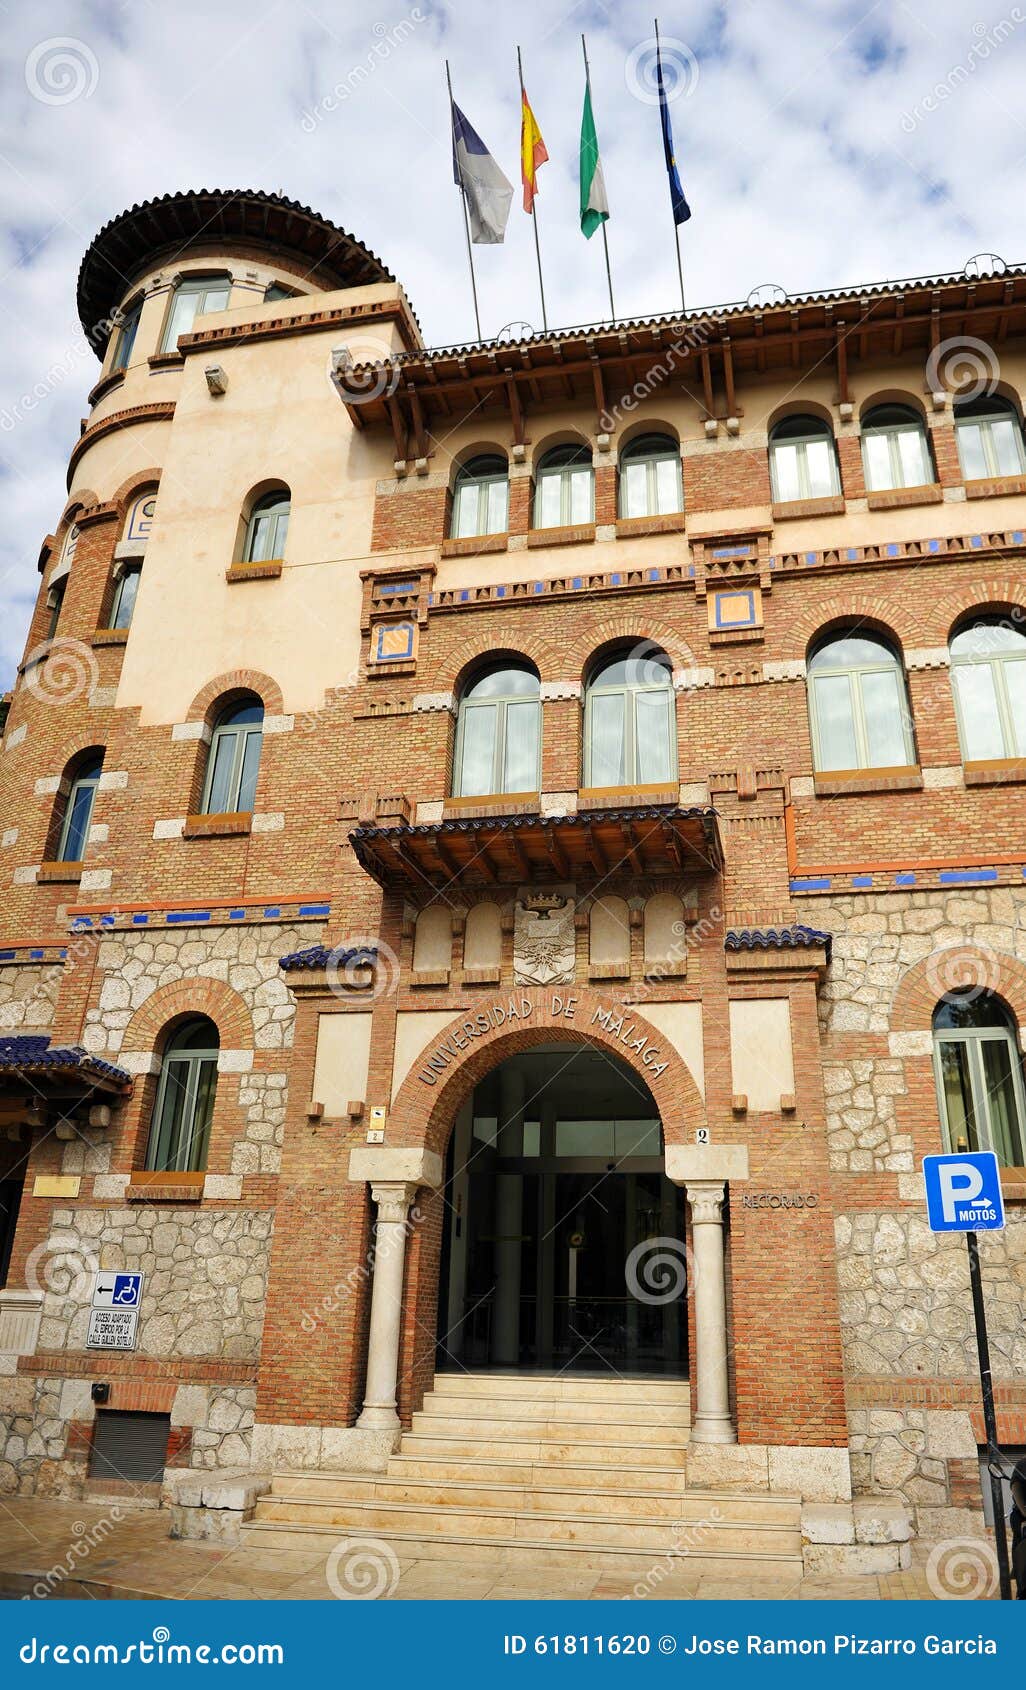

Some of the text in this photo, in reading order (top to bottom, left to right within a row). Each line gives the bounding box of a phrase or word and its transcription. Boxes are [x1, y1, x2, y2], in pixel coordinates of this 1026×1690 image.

[418, 996, 670, 1086] UNIVERSIDAD DE MÁLAGA
[372, 1132, 378, 1141] 2
[697, 1129, 708, 1144] 2
[938, 1163, 983, 1223] P
[742, 1193, 819, 1210] RECTORADO
[959, 1209, 997, 1222] MOTOS
[96, 1313, 132, 1324] ACCESO ADAPTADO
[115, 1324, 123, 1334] POR
